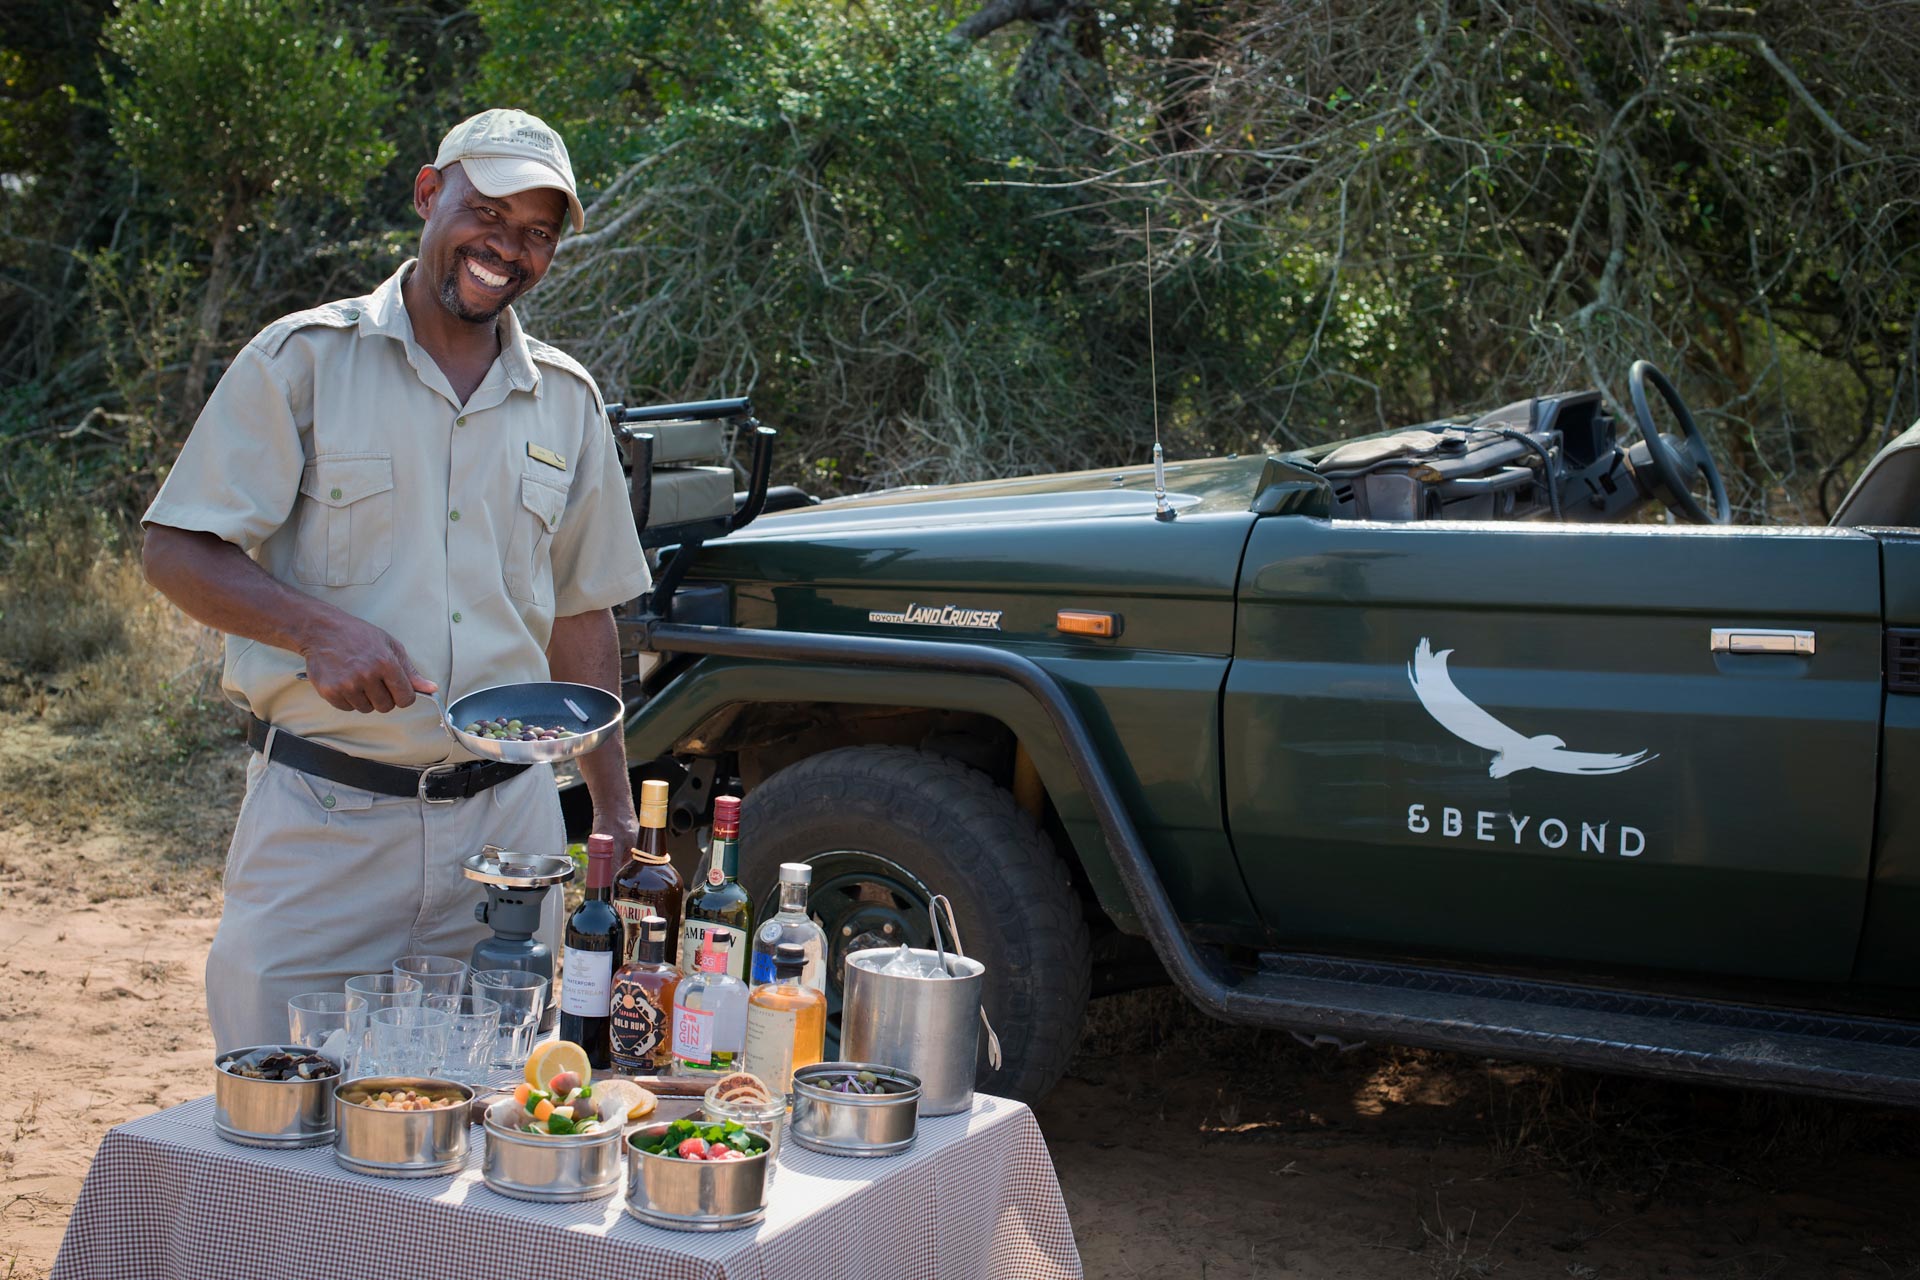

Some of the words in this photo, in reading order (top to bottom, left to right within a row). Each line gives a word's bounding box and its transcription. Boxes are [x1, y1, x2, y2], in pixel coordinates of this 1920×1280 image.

[870, 613, 901, 623] TOYOTA
[1407, 803, 1647, 857] &BEYOND
[630, 1021, 646, 1032] RUM
